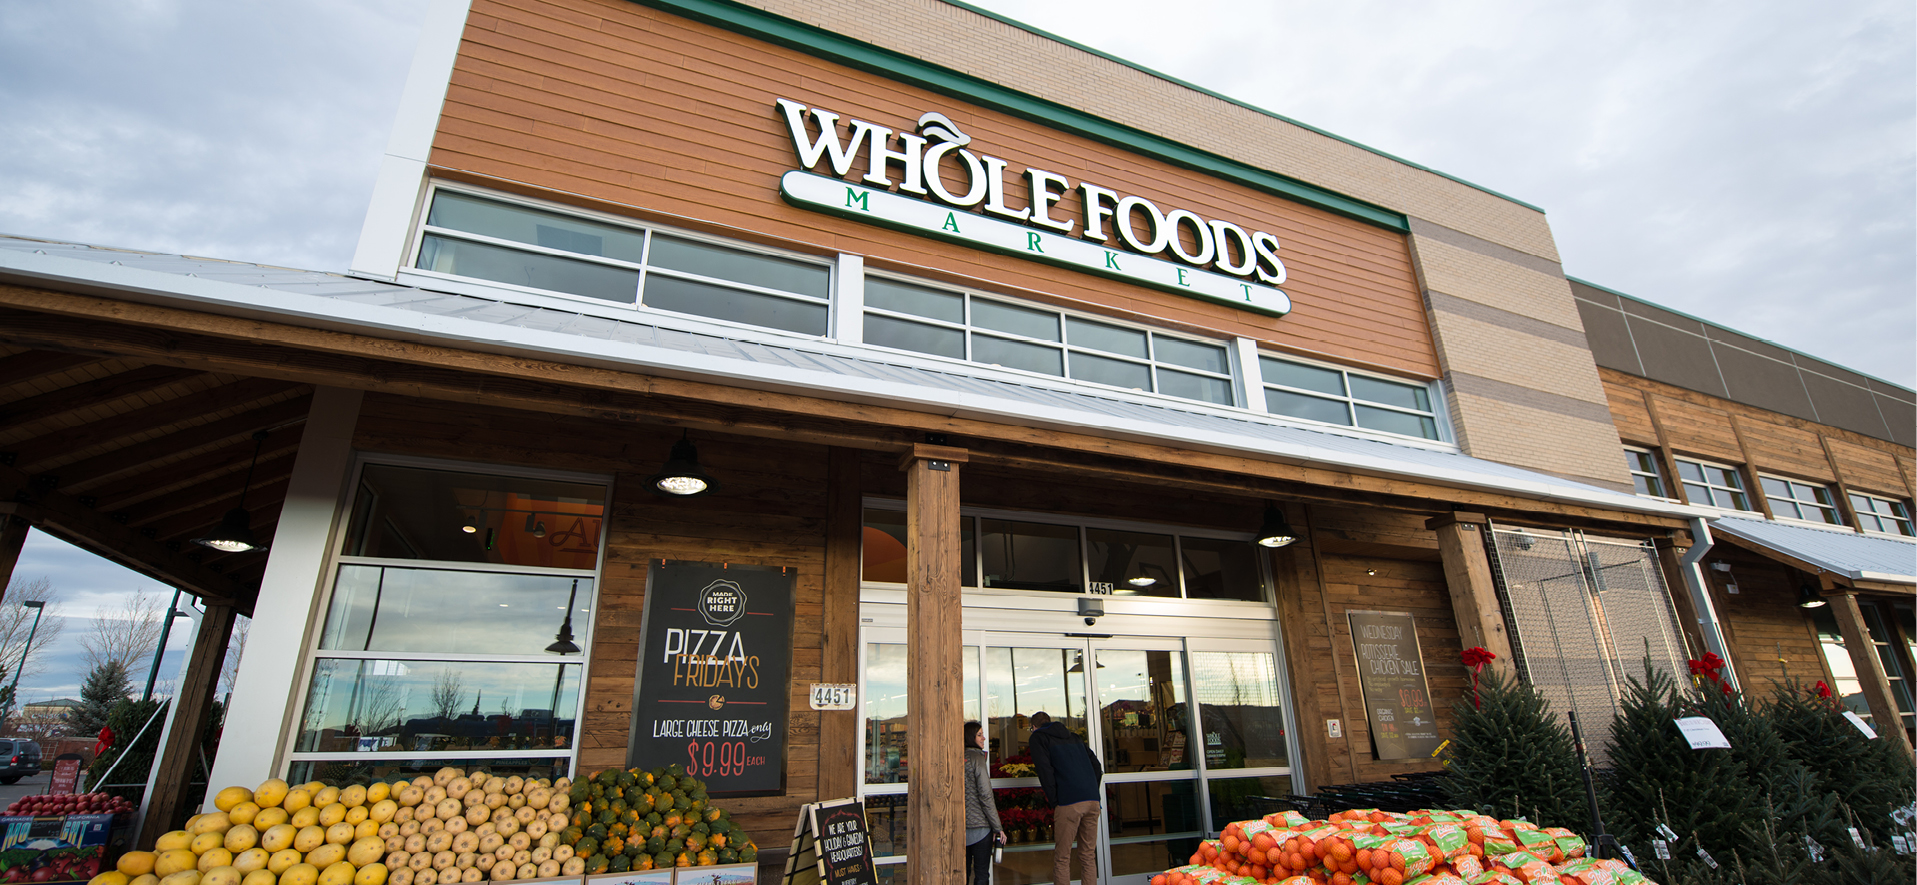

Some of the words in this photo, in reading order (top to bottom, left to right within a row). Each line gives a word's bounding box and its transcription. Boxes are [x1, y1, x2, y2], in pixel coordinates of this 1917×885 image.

[777, 98, 1074, 235] WHOLE
[1077, 182, 1287, 286] FOODS
[845, 187, 1253, 302] MARKET
[1089, 583, 1113, 595] 4451
[1360, 625, 1402, 640] WEDNESDAY
[663, 628, 747, 666] PIZZA
[1361, 644, 1400, 660] ROTISSERIE
[673, 654, 760, 689] FRIDAYS
[1370, 660, 1400, 675] CHICKEN
[1401, 660, 1419, 675] SALE
[815, 688, 850, 704] 4451
[1399, 688, 1424, 707] $6.99
[653, 720, 685, 738] LARGE
[686, 720, 720, 738] CHEESE
[722, 720, 748, 737] PIZZA
[748, 721, 772, 743] only
[686, 738, 746, 778] $9.99
[746, 756, 766, 766] EACH
[828, 824, 836, 836] WE
[837, 822, 846, 834] ARE
[846, 820, 858, 832] YOUR
[824, 836, 843, 852] HOLIDAY
[834, 867, 847, 878] MUST
